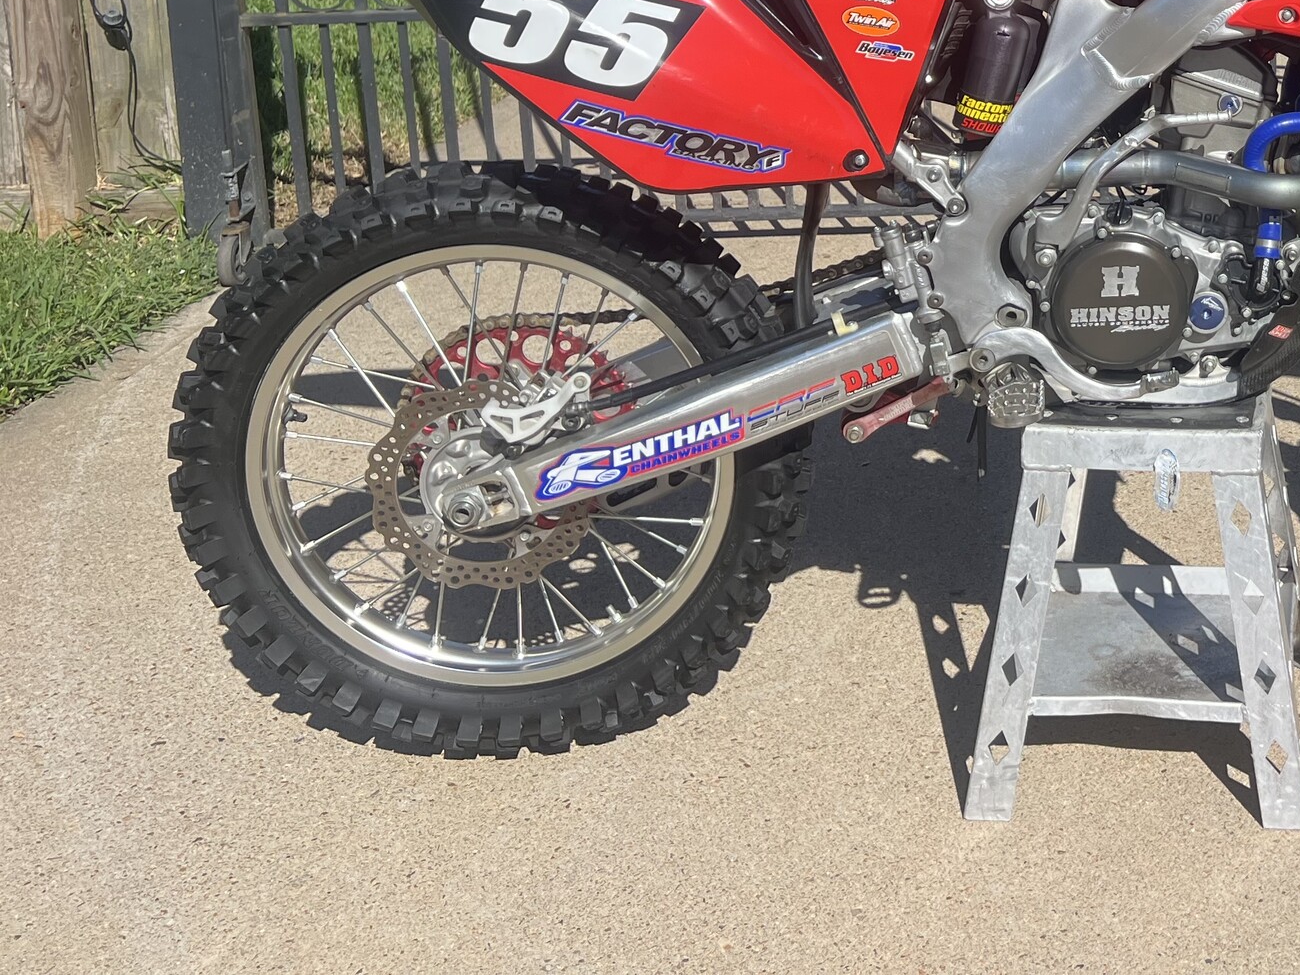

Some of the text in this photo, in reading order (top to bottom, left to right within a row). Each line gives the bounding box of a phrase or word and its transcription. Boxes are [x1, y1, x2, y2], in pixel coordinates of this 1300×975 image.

[848, 11, 877, 26] Twin
[875, 16, 897, 28] Air
[858, 42, 914, 59] Boyesen
[960, 94, 1014, 114] Factory
[564, 102, 782, 168] FACTORY
[671, 148, 755, 170] BACKING
[1100, 265, 1140, 297] H
[1070, 304, 1171, 323] HINSON
[630, 431, 741, 474] CHAINWHEELS
